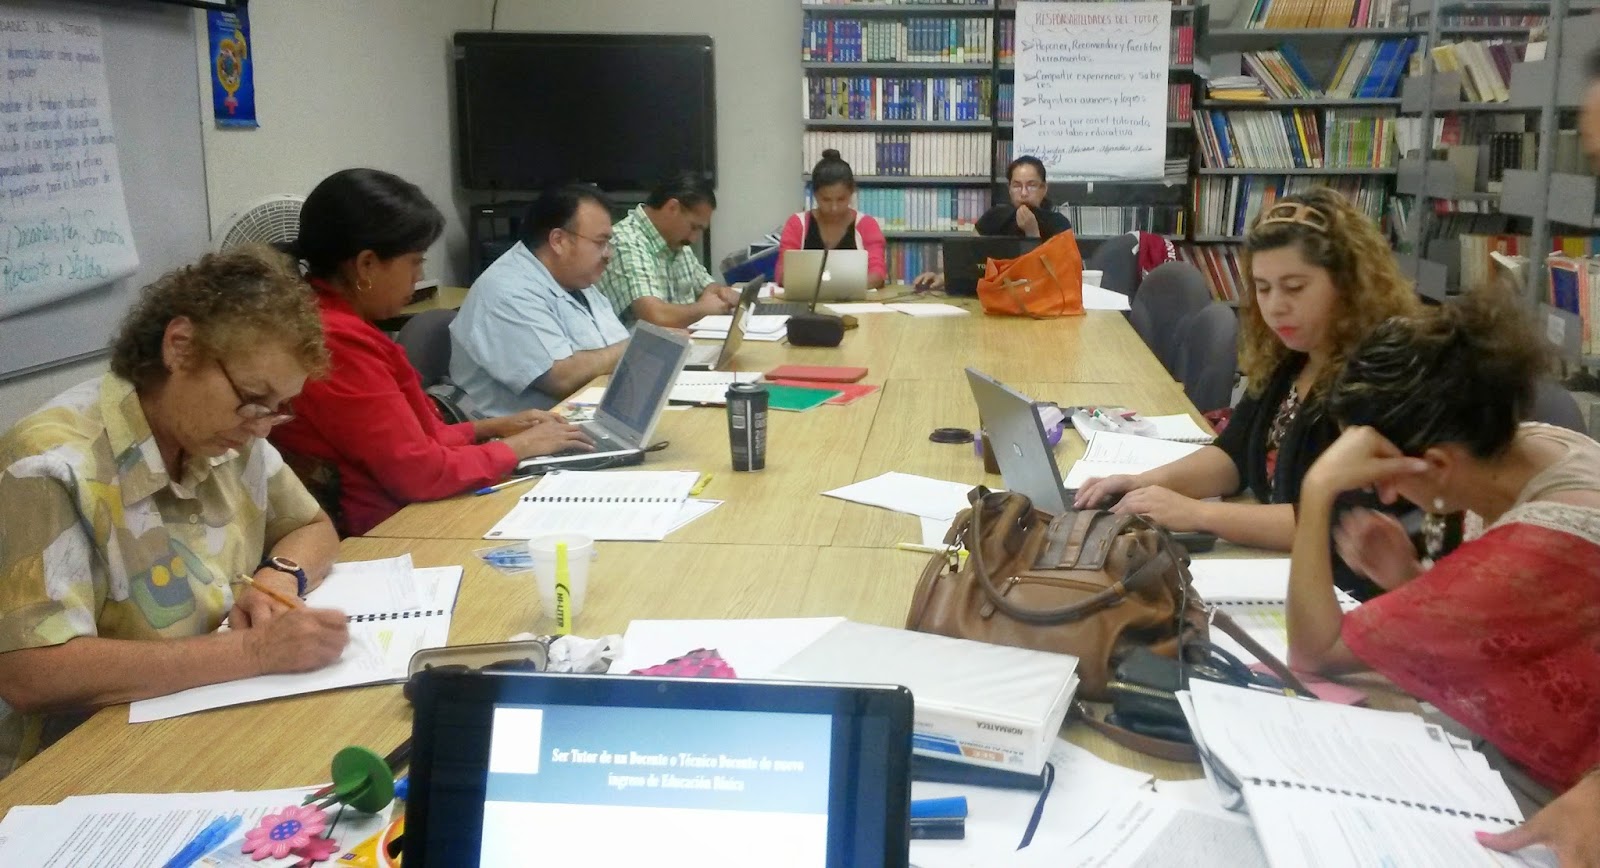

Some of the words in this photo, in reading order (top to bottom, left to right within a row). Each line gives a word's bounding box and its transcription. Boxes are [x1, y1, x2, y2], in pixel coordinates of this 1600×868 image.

[1133, 13, 1160, 25] TUTOR
[556, 592, 565, 628] HI-LITER
[977, 721, 1023, 735] NORMATECA
[552, 748, 569, 762] Ser
[570, 748, 598, 764] Tutor
[599, 749, 612, 765] de
[629, 750, 668, 766] Docente
[678, 752, 718, 768] Técnico
[719, 754, 758, 770] Docente
[646, 772, 659, 788] de
[661, 773, 712, 789] Educación
